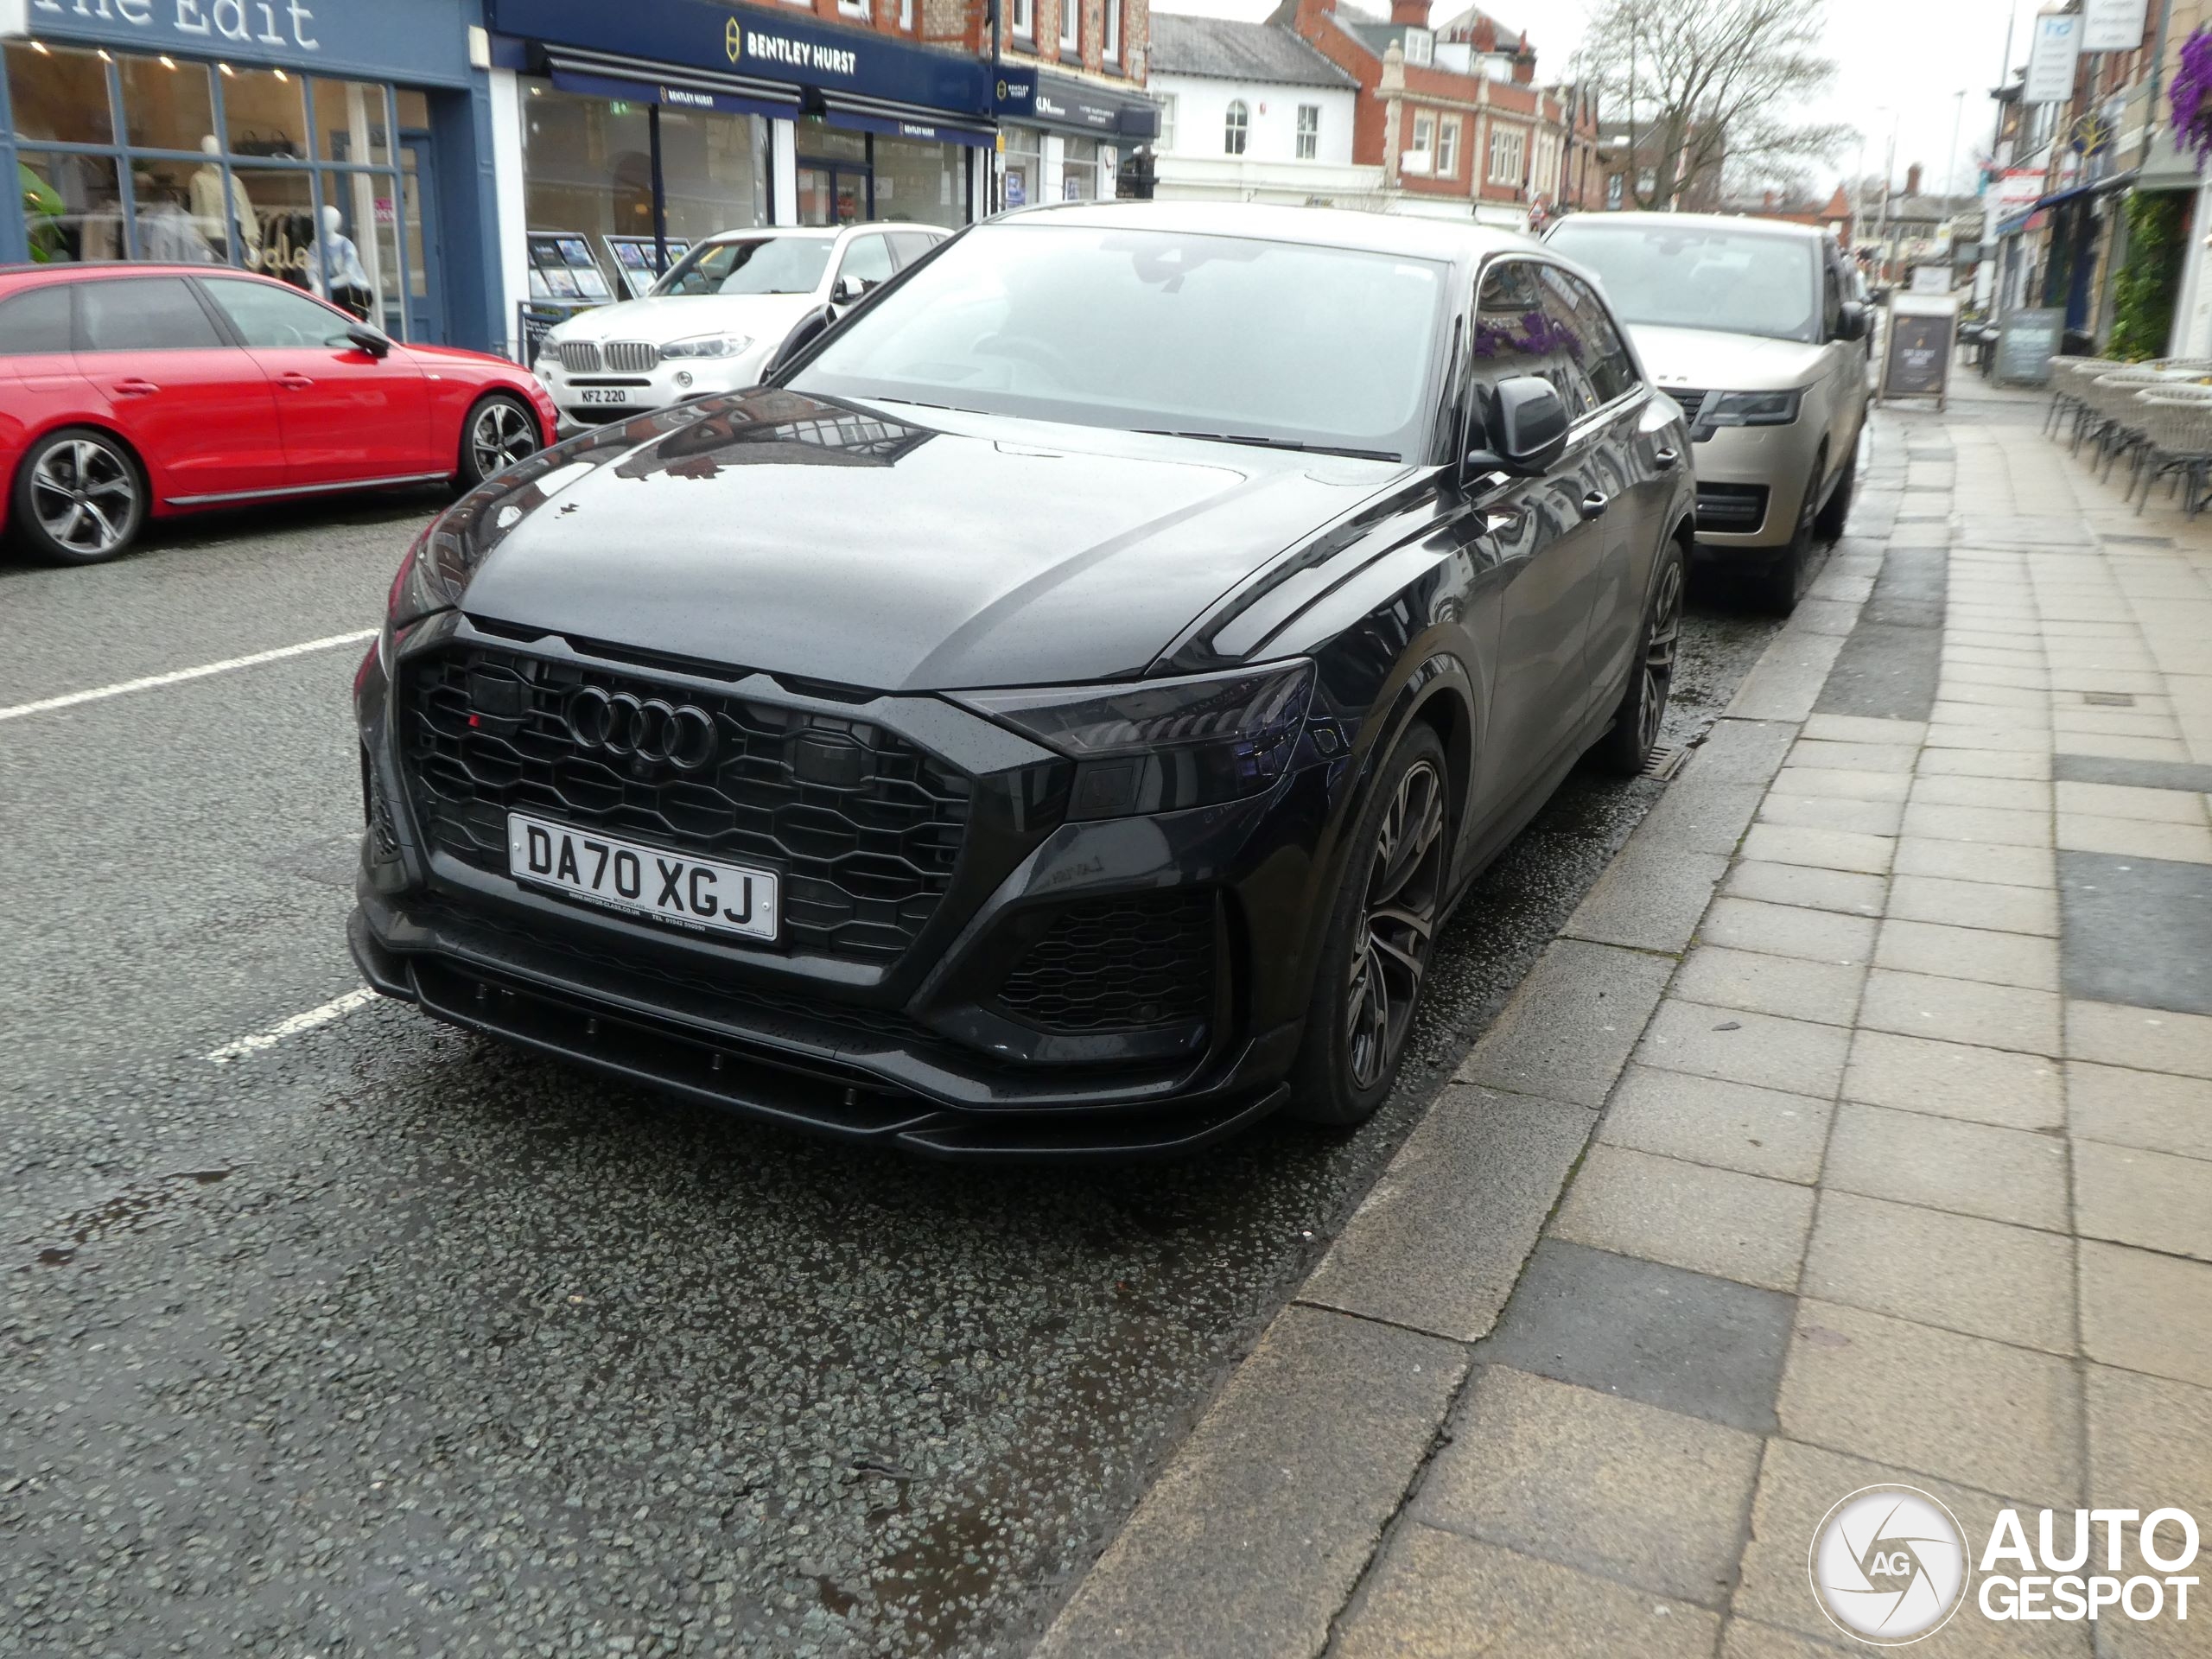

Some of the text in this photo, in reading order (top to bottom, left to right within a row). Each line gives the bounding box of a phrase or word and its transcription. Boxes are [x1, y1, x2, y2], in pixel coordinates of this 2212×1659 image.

[173, 0, 321, 50] Edit
[747, 31, 856, 75] BENTLEY HURST
[668, 89, 714, 107] BENTLEY HURST
[582, 390, 626, 403] KFZ 220
[526, 823, 752, 925] DA70 XGJ
